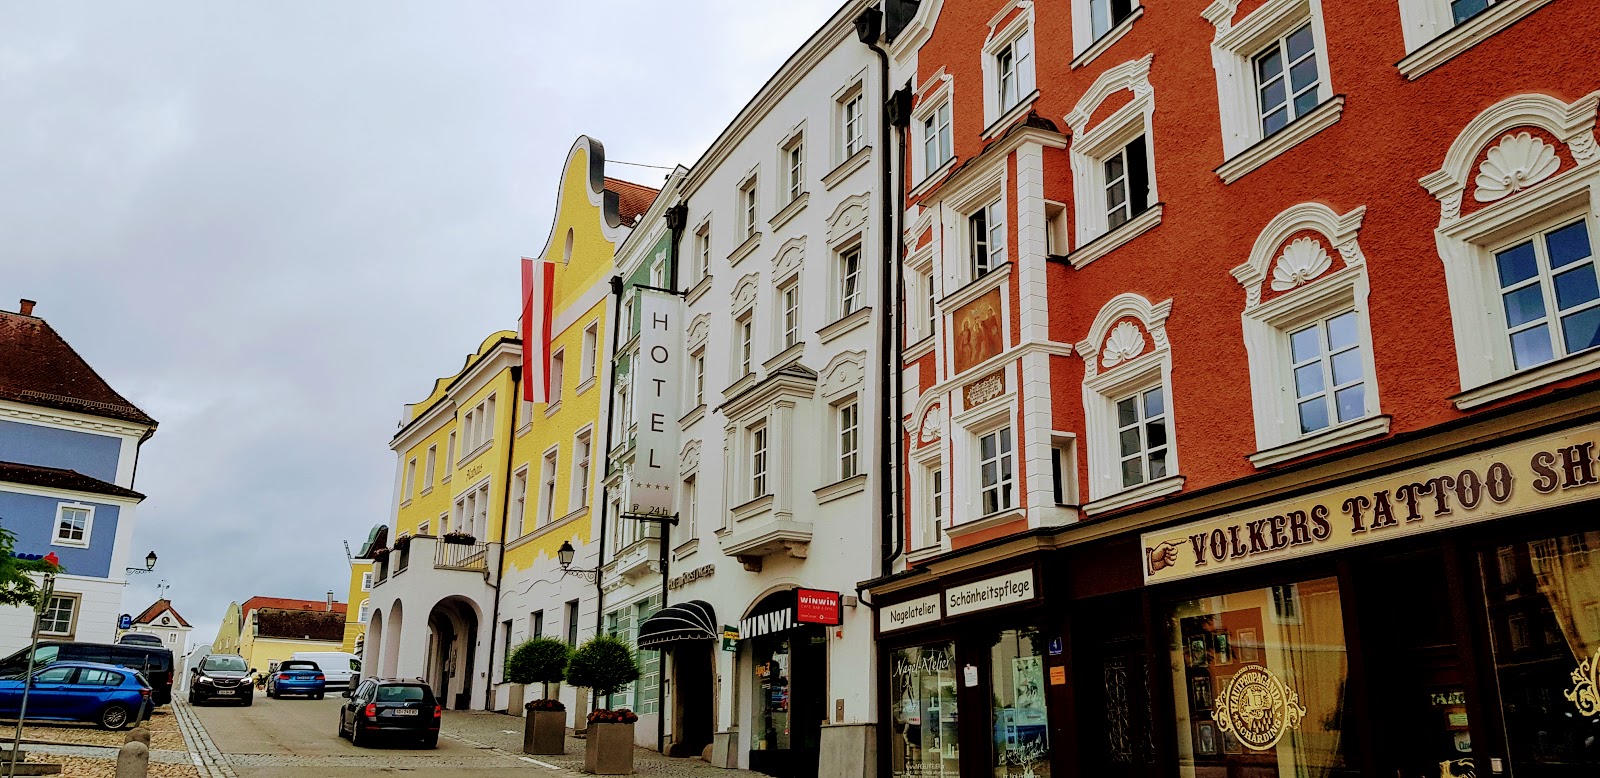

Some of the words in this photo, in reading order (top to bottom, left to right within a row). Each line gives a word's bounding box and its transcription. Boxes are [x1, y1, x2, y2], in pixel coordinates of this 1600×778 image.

[649, 312, 669, 469] HOTEL
[1188, 504, 1331, 565] VOLKERS
[1341, 462, 1514, 533] TATTOO
[1530, 440, 1600, 494] SH
[950, 580, 1030, 608] Schönheitspflege
[738, 607, 804, 640] WINWI
[890, 602, 936, 624] Nagelatelier
[1230, 672, 1282, 714] HAUTPROPAGANDA
[1235, 719, 1282, 744] SCHÄRDING
